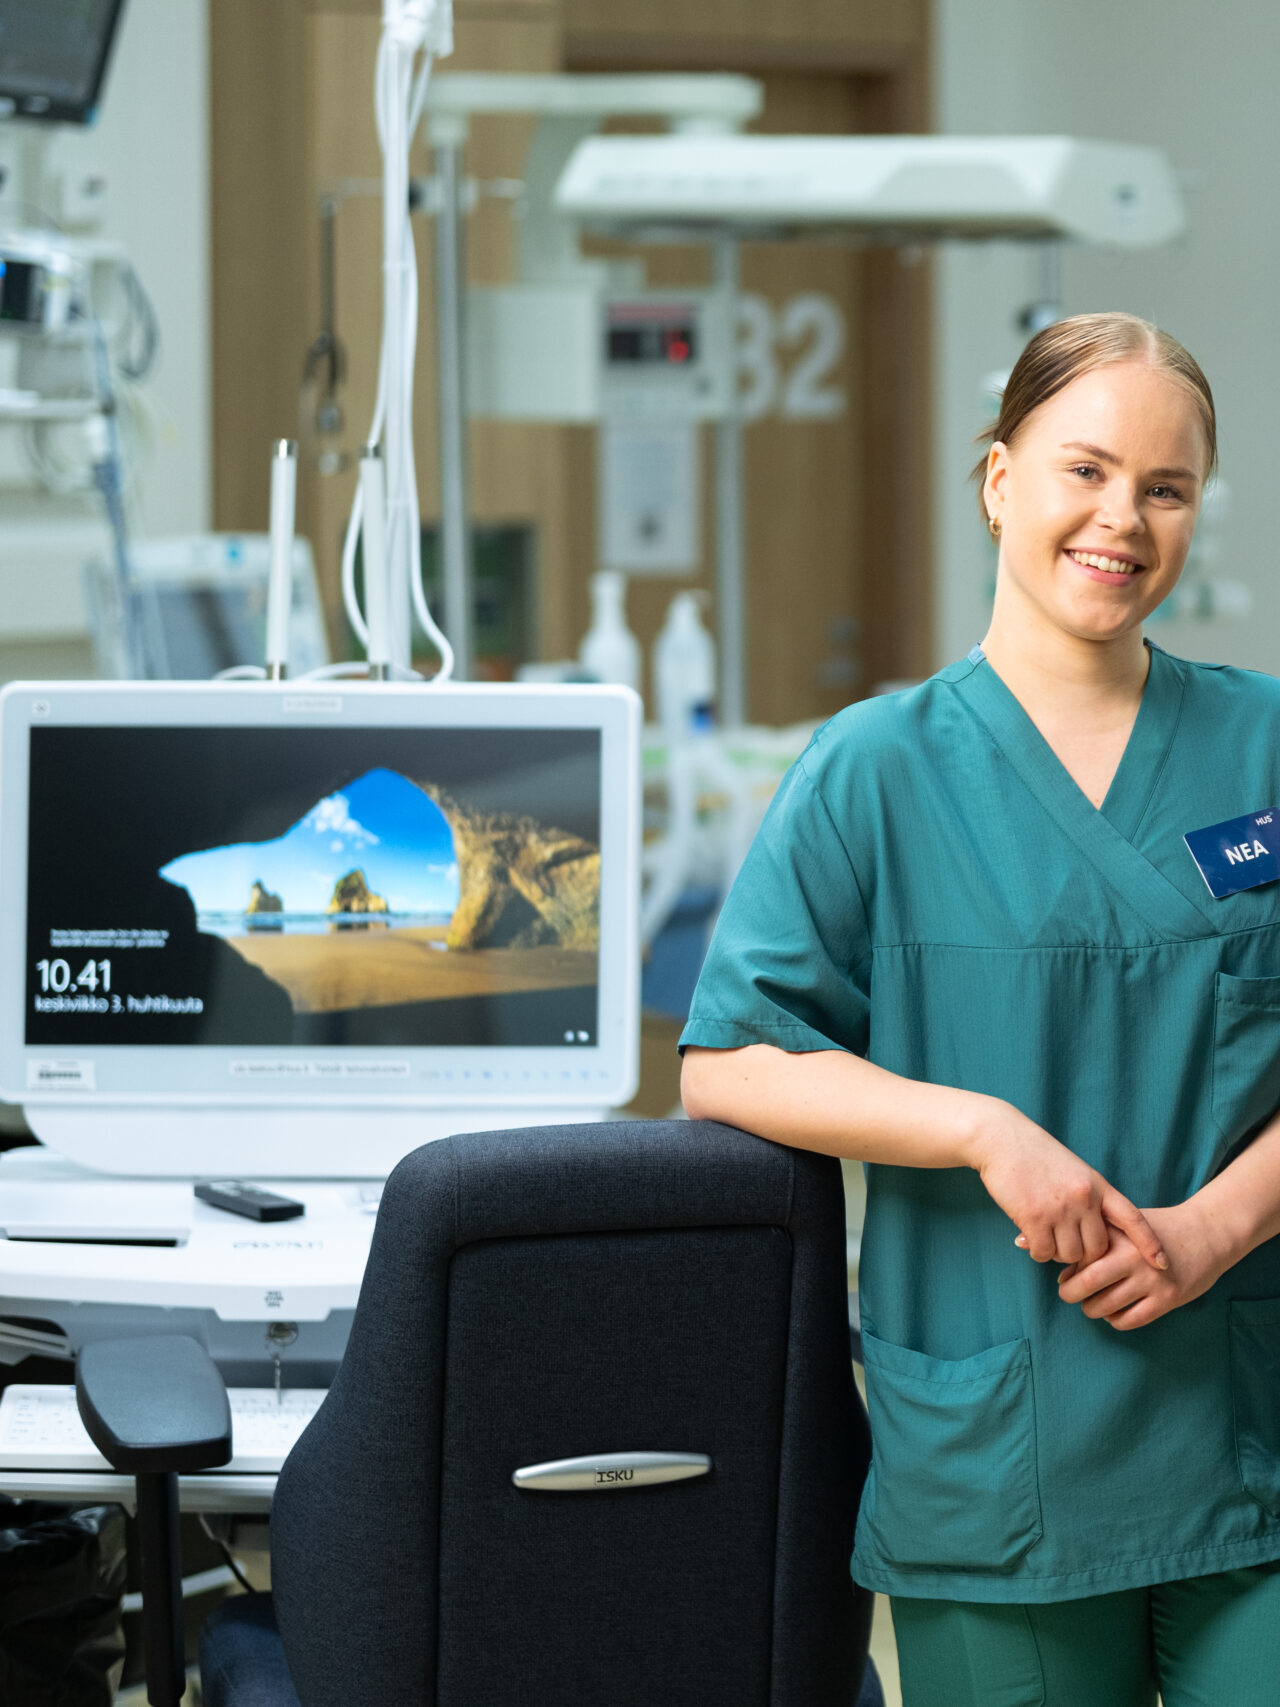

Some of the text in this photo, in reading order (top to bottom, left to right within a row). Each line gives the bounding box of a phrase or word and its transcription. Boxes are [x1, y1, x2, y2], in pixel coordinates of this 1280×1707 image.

[1255, 815, 1273, 825] HUS
[1225, 839, 1270, 865] NEA
[37, 959, 112, 993] 10.41
[597, 1469, 634, 1483] ISKU
